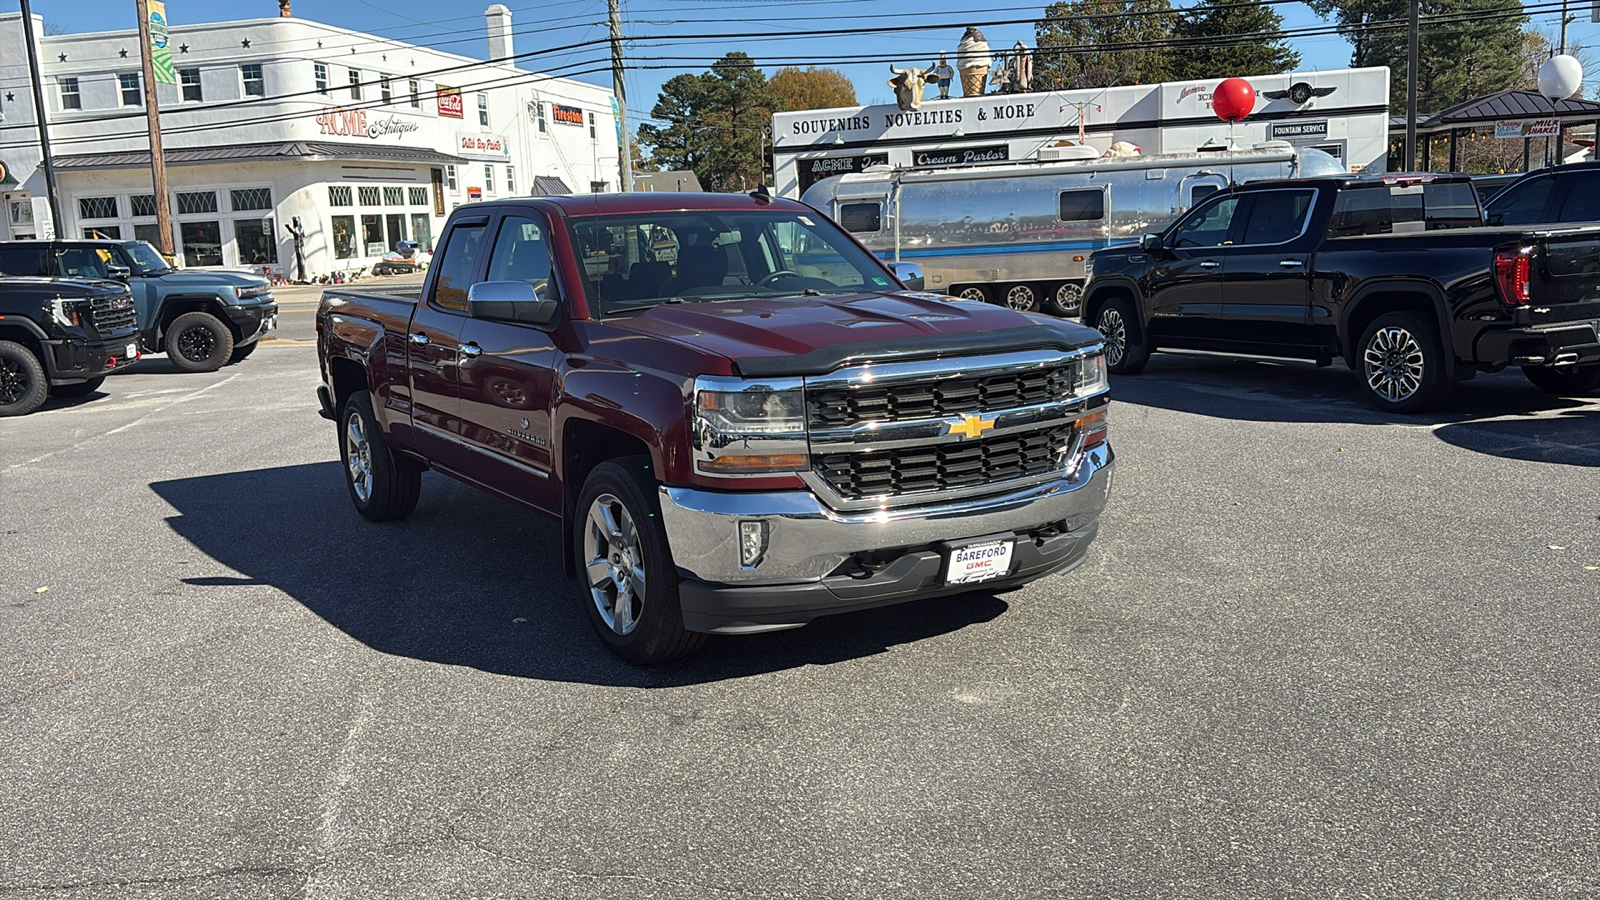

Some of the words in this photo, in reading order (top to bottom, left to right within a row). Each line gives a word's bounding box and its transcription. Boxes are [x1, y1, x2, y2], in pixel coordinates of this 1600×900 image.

[552, 104, 583, 123] Firestone
[793, 116, 870, 135] SOUVENIRS
[885, 109, 962, 128] NOVELTIES
[977, 107, 987, 121] &
[993, 104, 1035, 120] MORE
[316, 106, 369, 137] ACME
[1534, 119, 1560, 127] MILK
[1274, 126, 1301, 135] FOUNTAIN
[1302, 124, 1326, 133] SERVICE
[1528, 127, 1558, 135] SHAKES
[462, 137, 475, 149] Dutch
[477, 138, 486, 152] Boy
[487, 139, 501, 151] Paints
[812, 158, 853, 172] ACME
[917, 153, 958, 165] Cream
[963, 150, 1006, 163] Parlor
[956, 546, 1006, 562] BAREFORD
[966, 560, 993, 569] GMC
